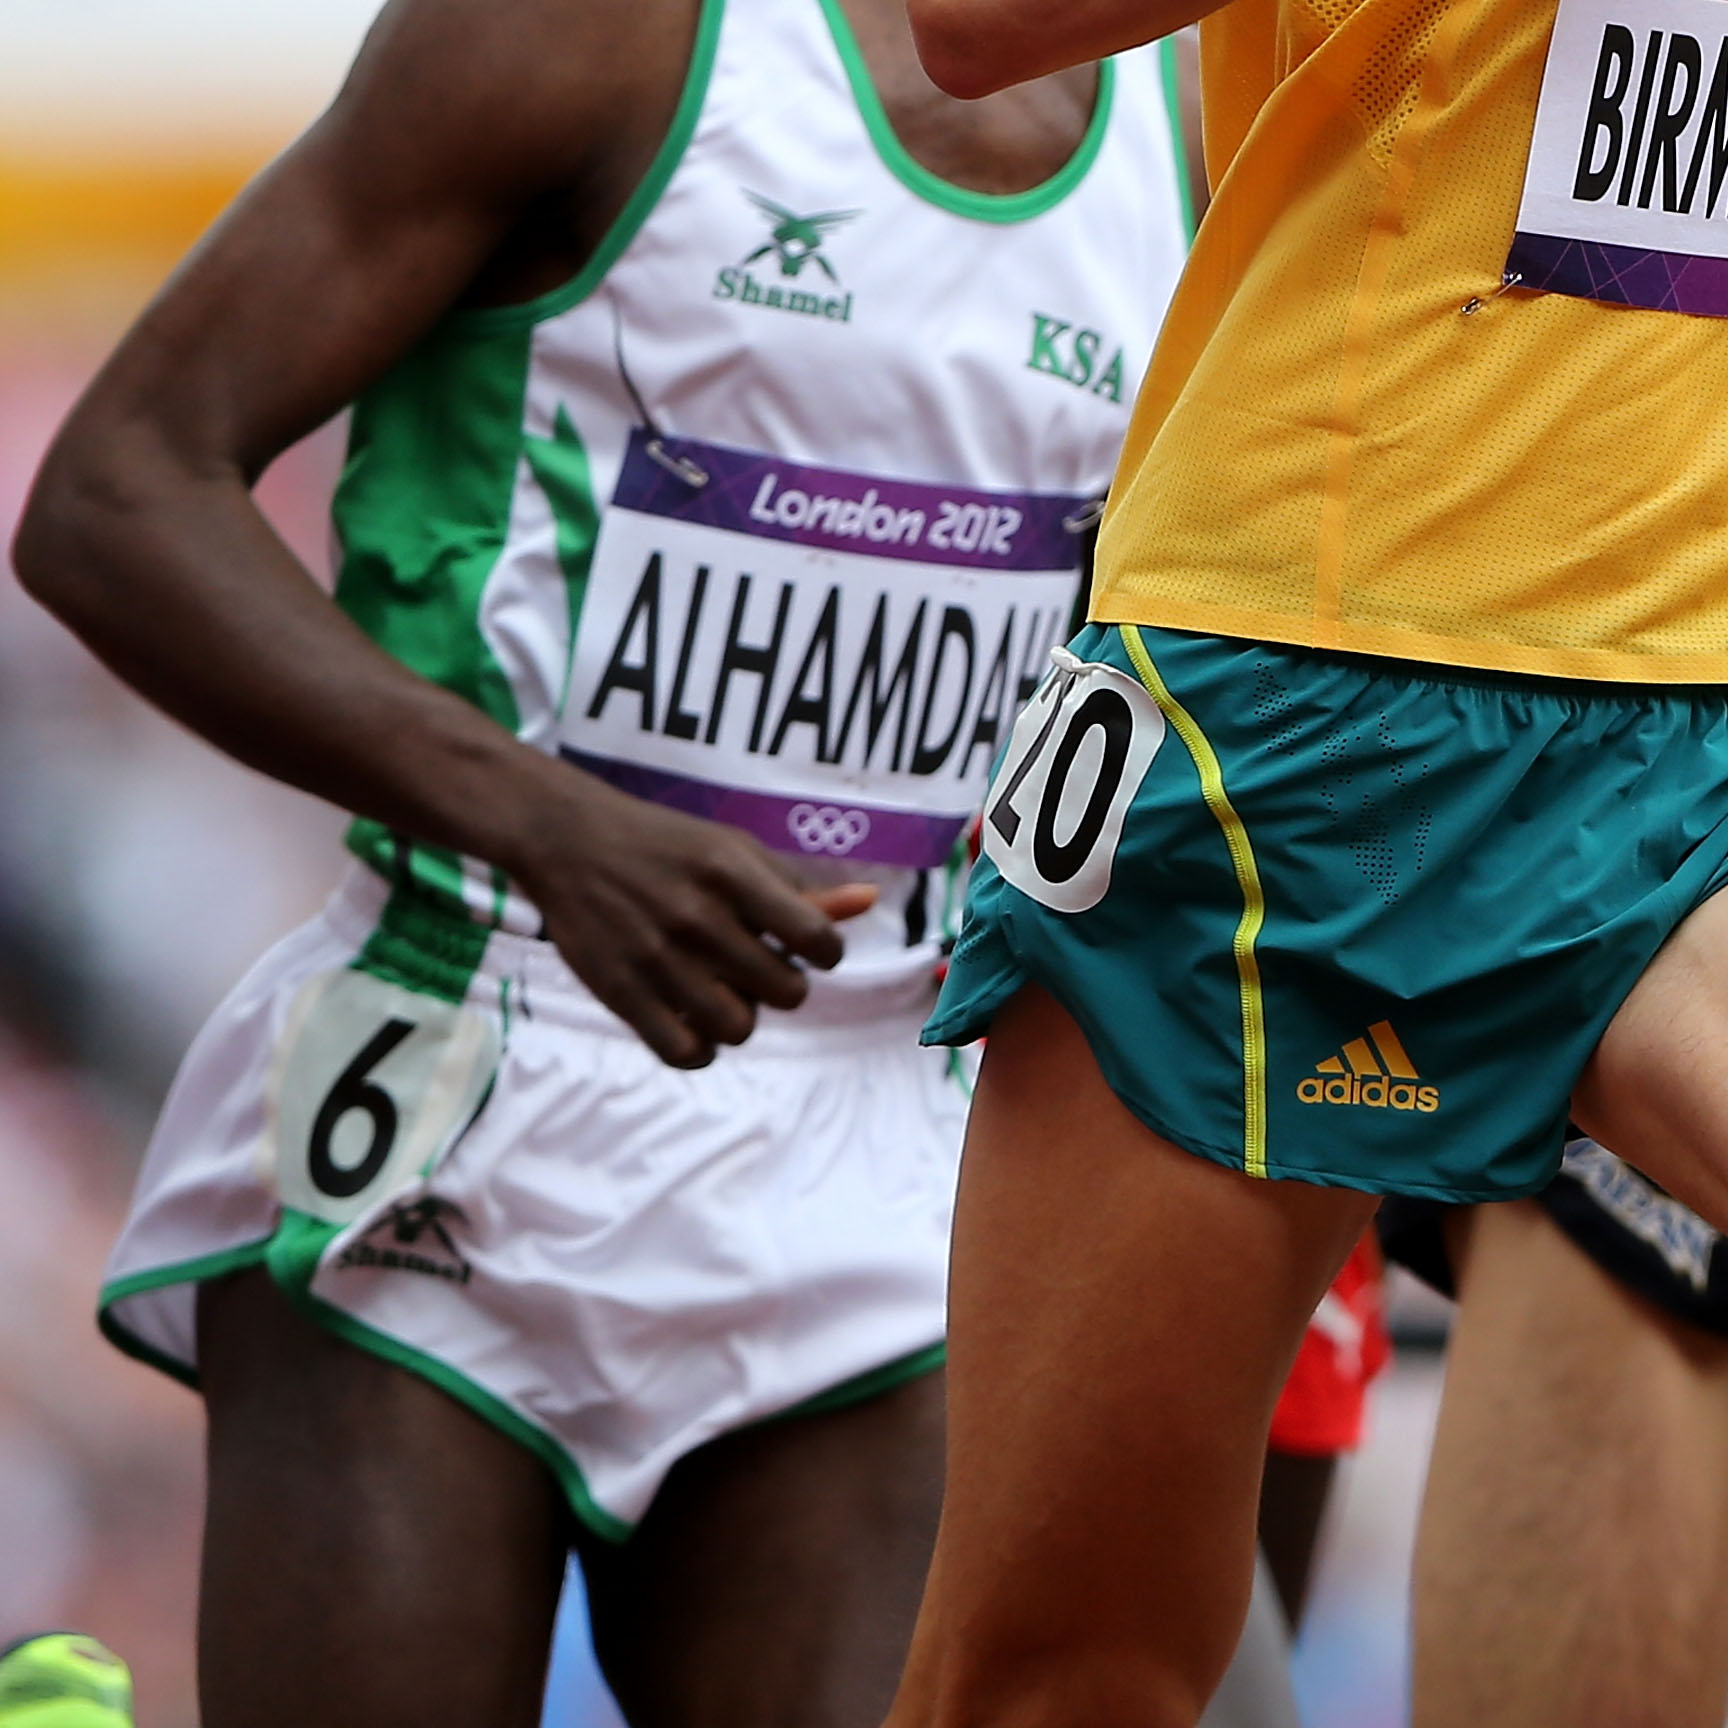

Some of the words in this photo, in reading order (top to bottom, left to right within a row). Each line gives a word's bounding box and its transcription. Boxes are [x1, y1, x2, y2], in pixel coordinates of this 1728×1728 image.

[713, 269, 852, 323] Shamel
[1027, 312, 1125, 404] KSA
[751, 471, 921, 546] London
[928, 500, 1022, 555] 2012
[989, 667, 1134, 885] 20
[308, 1017, 416, 1199] 6
[1296, 1071, 1440, 1113] adidas
